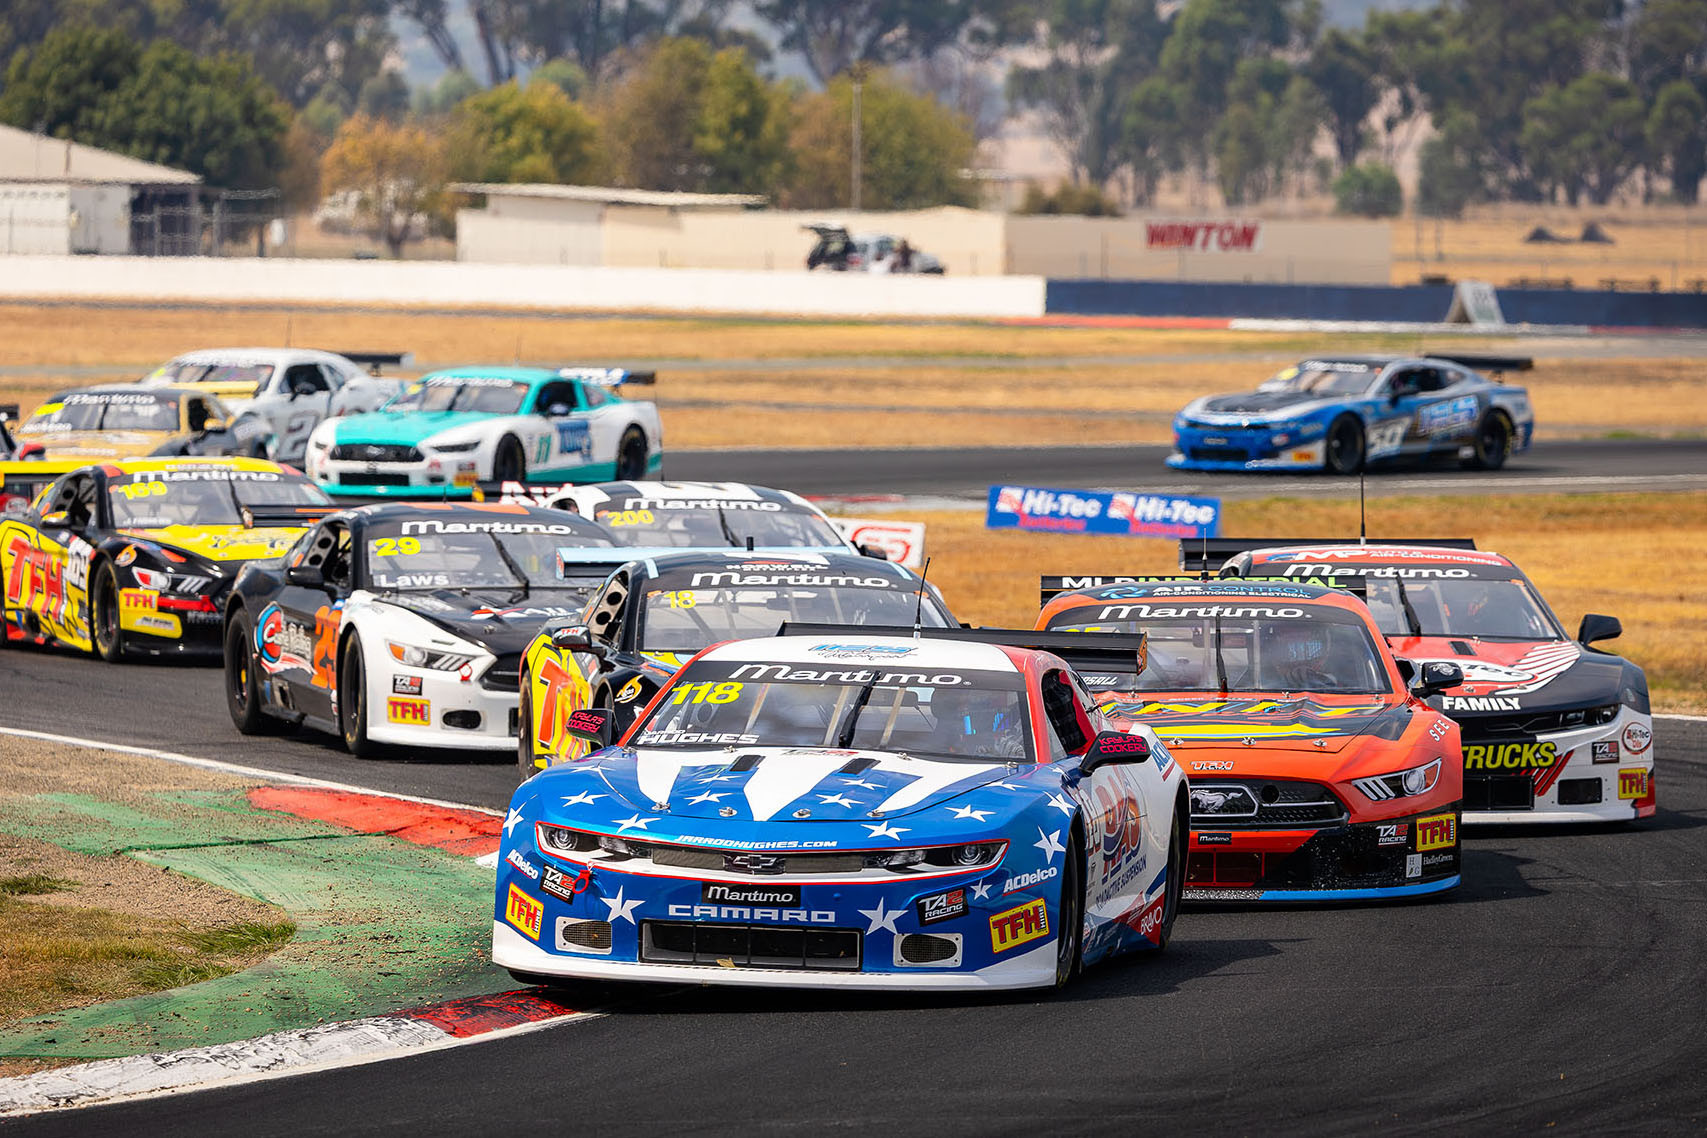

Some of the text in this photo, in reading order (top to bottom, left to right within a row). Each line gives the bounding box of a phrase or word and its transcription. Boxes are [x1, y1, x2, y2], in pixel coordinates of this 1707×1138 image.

[1146, 222, 1259, 250] WINTON
[133, 471, 279, 483] Maritimo
[118, 481, 168, 500] 169
[624, 498, 781, 512] Maritimo
[402, 520, 572, 535] Maritimo
[607, 510, 654, 527] 200
[375, 537, 421, 556] 29
[8, 536, 63, 624] TFH
[690, 572, 889, 588] Maritimo
[1283, 564, 1470, 578] Maritimo
[663, 590, 696, 609] 18
[1209, 586, 1311, 595] CONTROL
[124, 593, 153, 608] TFH
[1098, 605, 1304, 619] Maritimo
[728, 664, 962, 686] Maritimo
[670, 682, 744, 706] 118
[389, 701, 424, 720] TFH
[1443, 697, 1521, 711] FAMILY
[637, 733, 760, 745] HUGHES
[1429, 719, 1450, 742] SEE
[1100, 743, 1147, 754] COOKERY
[1620, 773, 1644, 794] TFH
[1376, 824, 1408, 837] TA2
[1419, 819, 1451, 845] TFH
[675, 835, 838, 849] JARRODHUGHES.COM
[506, 849, 539, 879] ACDelco
[544, 865, 574, 890] TA2
[1002, 866, 1057, 894] ACDelco
[543, 880, 571, 896] RACING
[707, 886, 794, 902] Maritimo
[511, 889, 538, 929] TFH
[918, 889, 964, 910] TA2
[668, 904, 836, 923] CAMARO
[925, 902, 963, 918] RACING
[992, 906, 1041, 944] TFH
[1141, 906, 1163, 935] BRAVO
